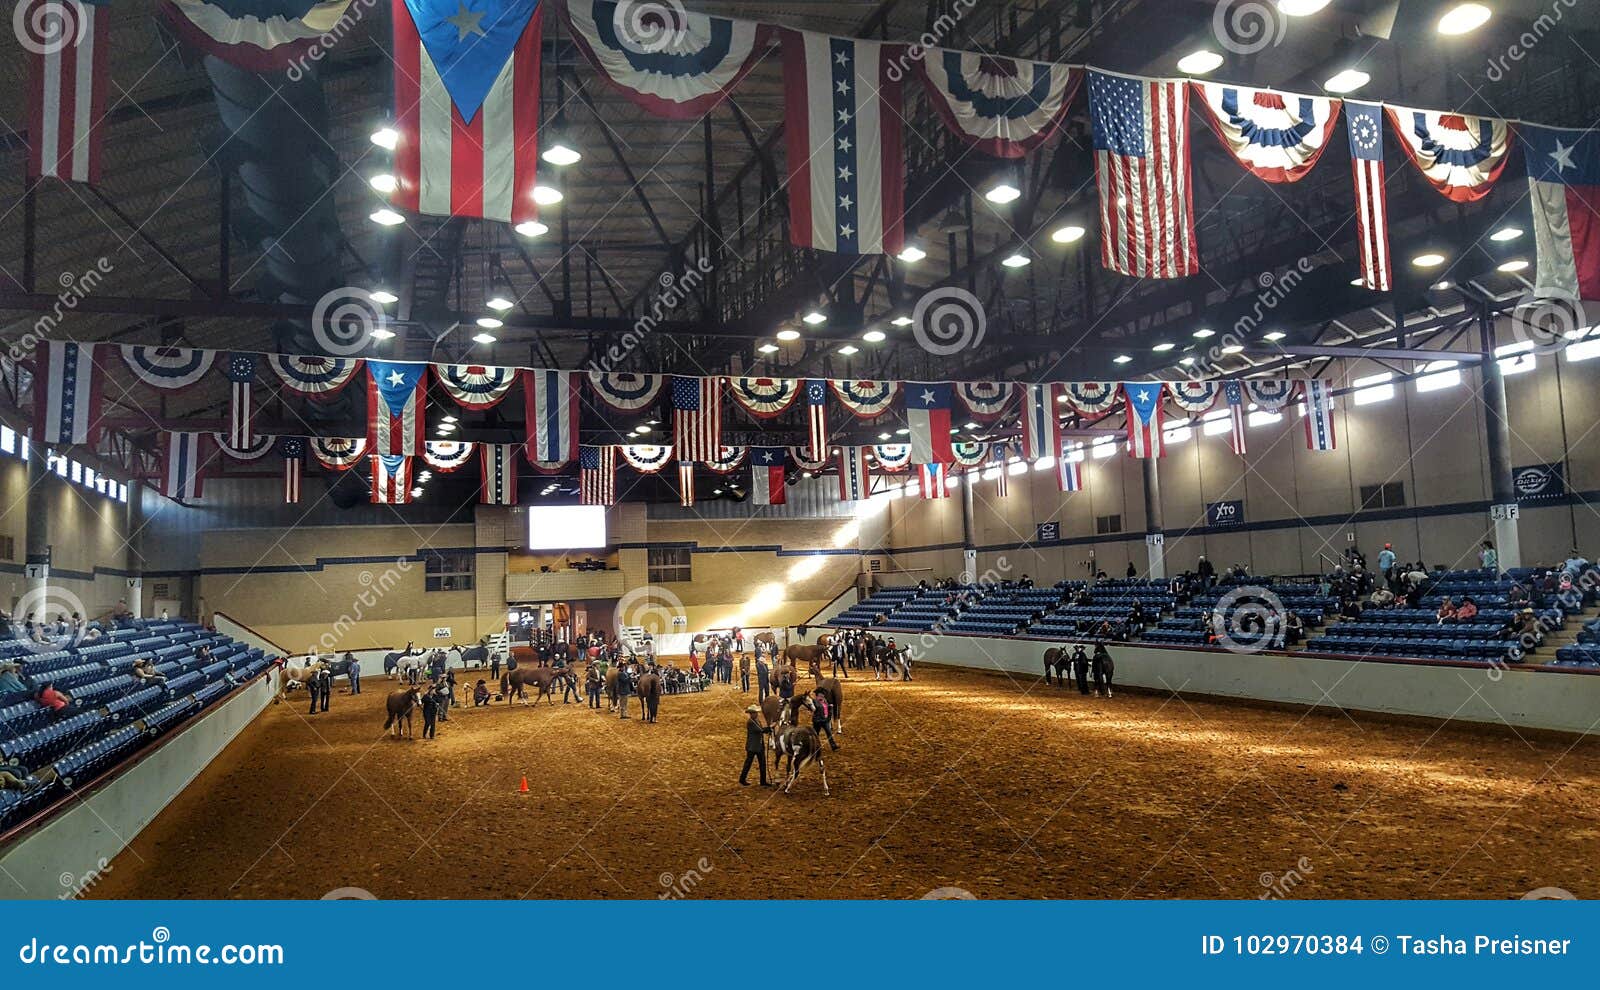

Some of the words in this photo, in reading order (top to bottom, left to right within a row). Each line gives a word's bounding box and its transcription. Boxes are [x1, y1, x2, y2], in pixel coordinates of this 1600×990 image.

[1216, 503, 1235, 520] XTO
[1510, 508, 1516, 519] F
[30, 567, 37, 578] T
